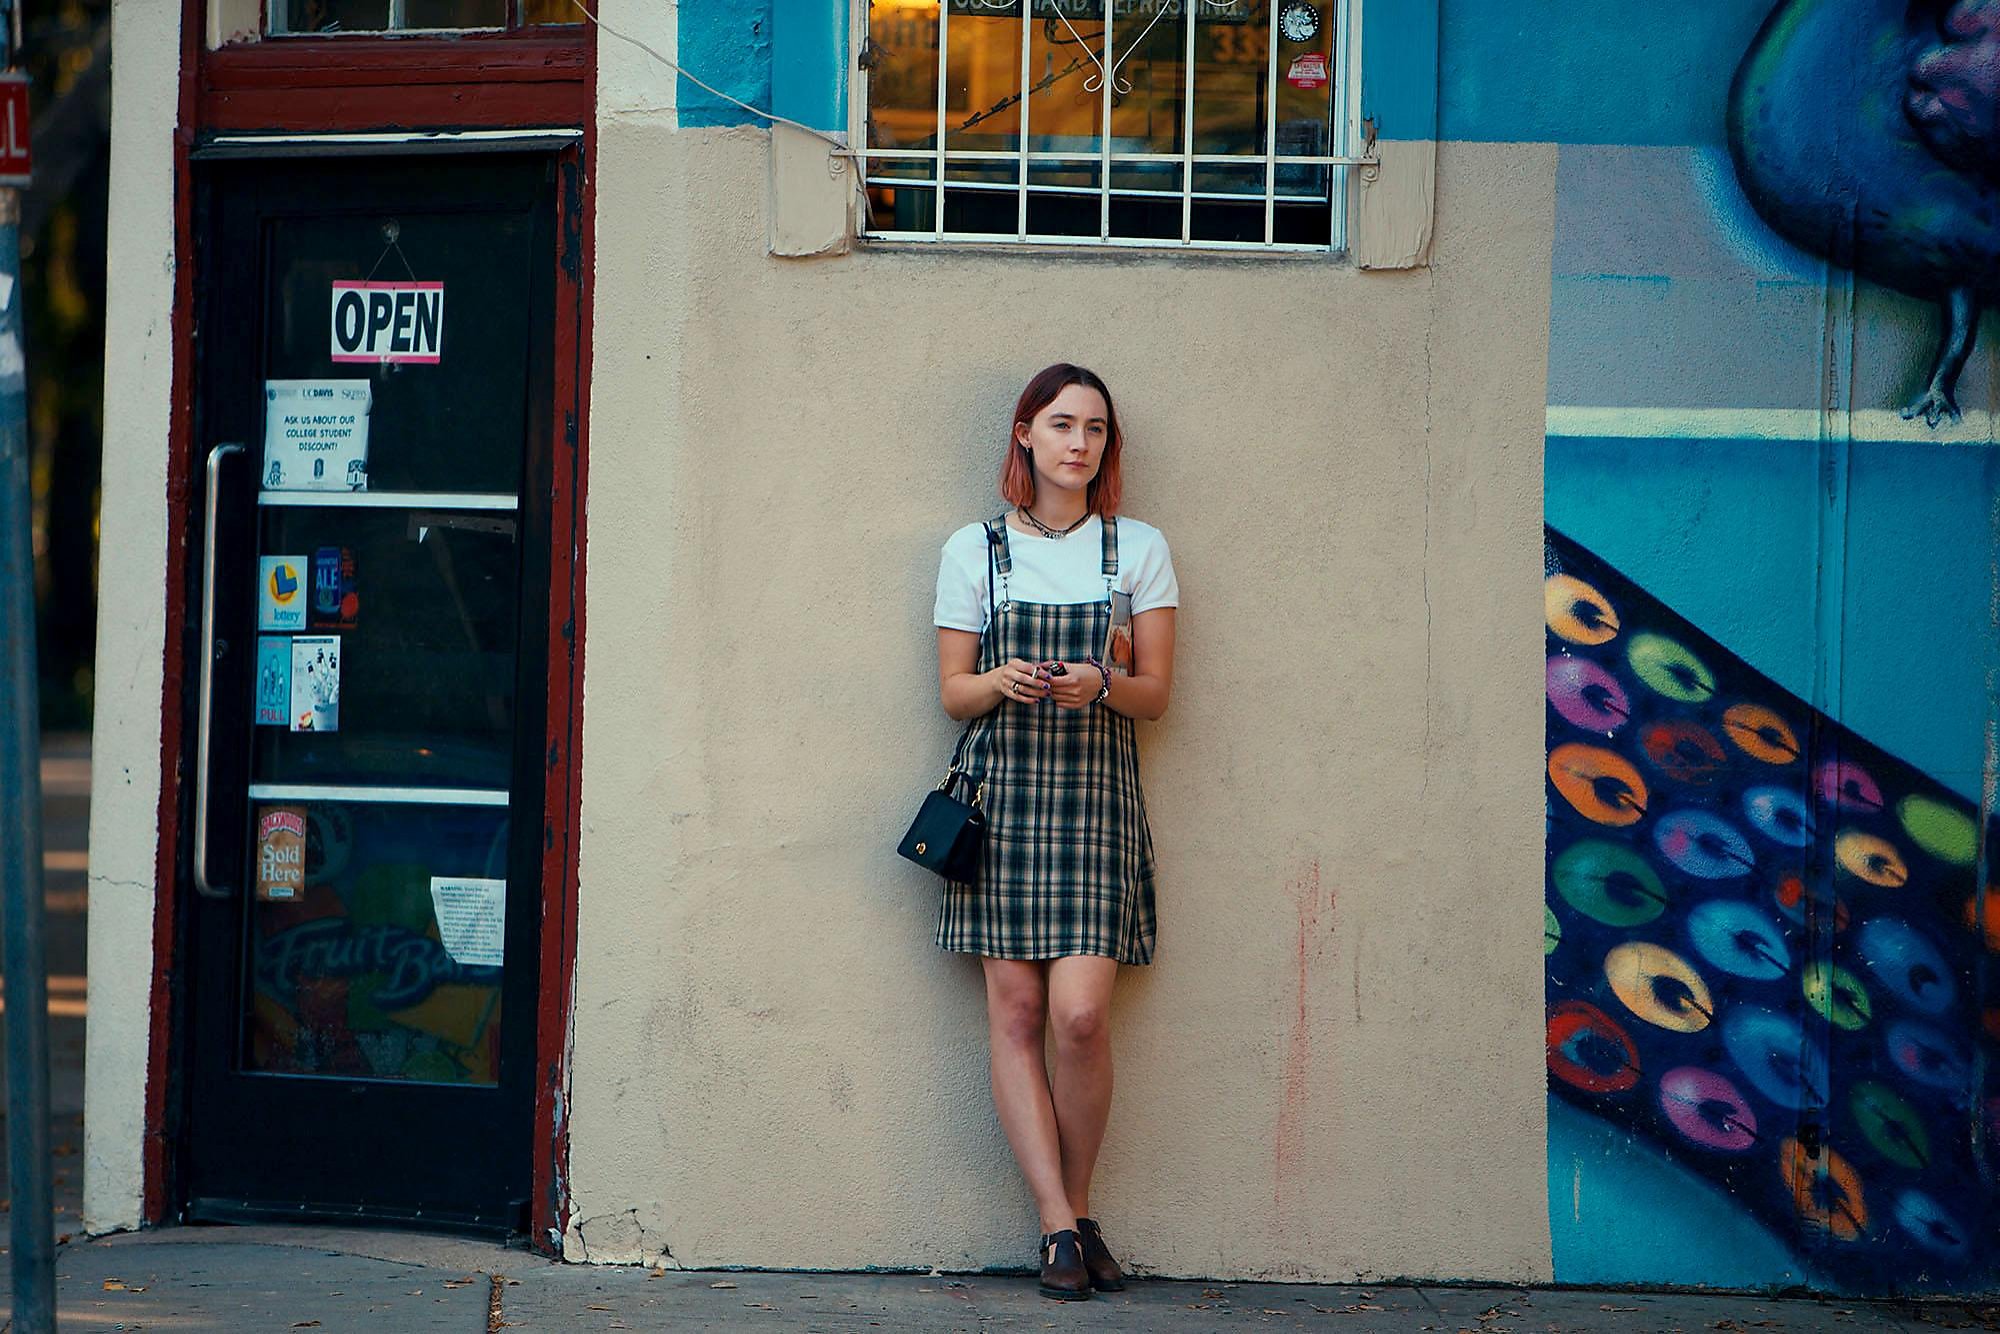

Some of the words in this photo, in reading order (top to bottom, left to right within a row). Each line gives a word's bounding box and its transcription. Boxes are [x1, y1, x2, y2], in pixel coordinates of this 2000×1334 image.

[0, 98, 27, 158] L
[335, 291, 440, 353] OPEN
[284, 416, 298, 425] ASK
[301, 416, 311, 425] US
[312, 416, 337, 425] ABOUT
[339, 416, 355, 425] OUR
[286, 429, 316, 438] COLLEGE
[320, 429, 352, 438] STUDENT
[298, 442, 337, 452] DISCOUNT!
[316, 567, 338, 589] ALE
[260, 707, 285, 721] PULL
[262, 844, 300, 864] Sold
[261, 863, 300, 882] Here
[260, 916, 404, 996] Fruit
